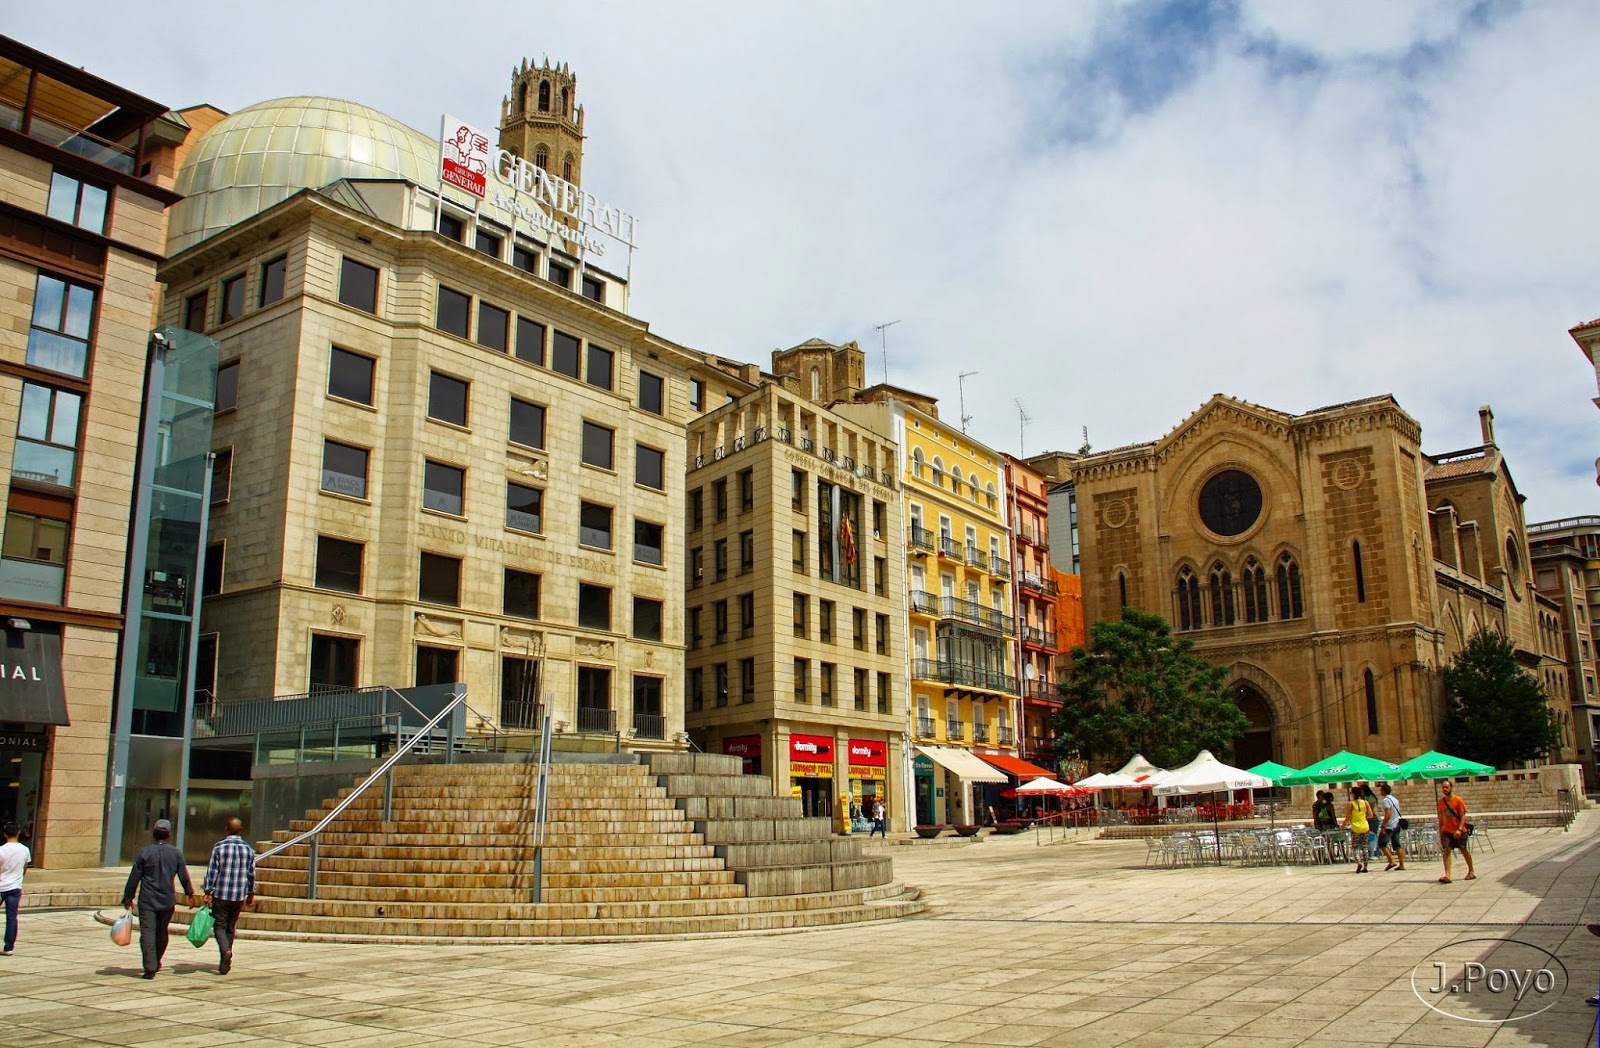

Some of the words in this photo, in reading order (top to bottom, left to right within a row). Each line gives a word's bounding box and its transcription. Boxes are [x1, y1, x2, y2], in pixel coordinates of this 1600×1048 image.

[442, 168, 485, 197] GENERALI
[454, 166, 475, 181] GRUPO
[493, 149, 639, 244] GENERALI
[337, 475, 359, 487] BANCA
[337, 483, 360, 493] MARCH
[418, 523, 466, 545] BANCO
[474, 534, 541, 562] VITALICIO
[548, 551, 563, 565] DE
[569, 555, 617, 576] ESPAÑA
